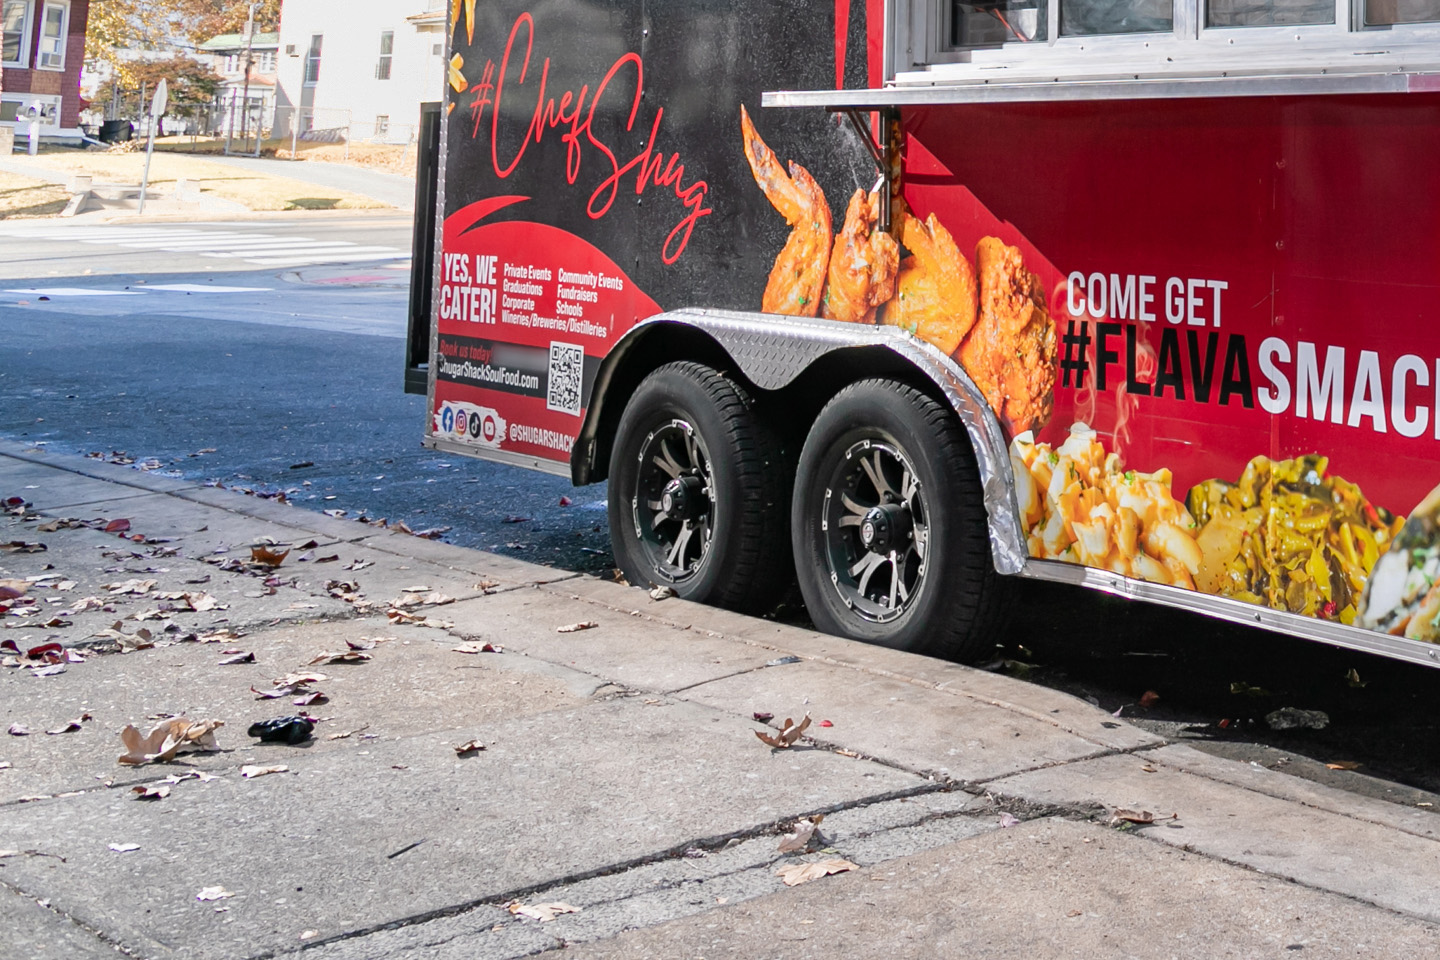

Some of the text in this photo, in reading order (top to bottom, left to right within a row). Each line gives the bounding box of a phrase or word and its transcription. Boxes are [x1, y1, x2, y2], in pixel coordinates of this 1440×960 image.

[444, 253, 498, 288] YES, WE
[504, 263, 552, 282] Private Events
[558, 268, 623, 291] Community Events
[503, 279, 543, 296] Graduations
[557, 284, 598, 303] Fundraisers
[1067, 270, 1229, 327] COME GET
[440, 284, 496, 324] CATER!
[502, 294, 535, 311] Corporate
[556, 300, 583, 317] Schools
[440, 339, 458, 357] Book
[459, 345, 468, 358] us
[469, 344, 493, 365] today!
[439, 357, 539, 390] ShugarShackSoulFood.com
